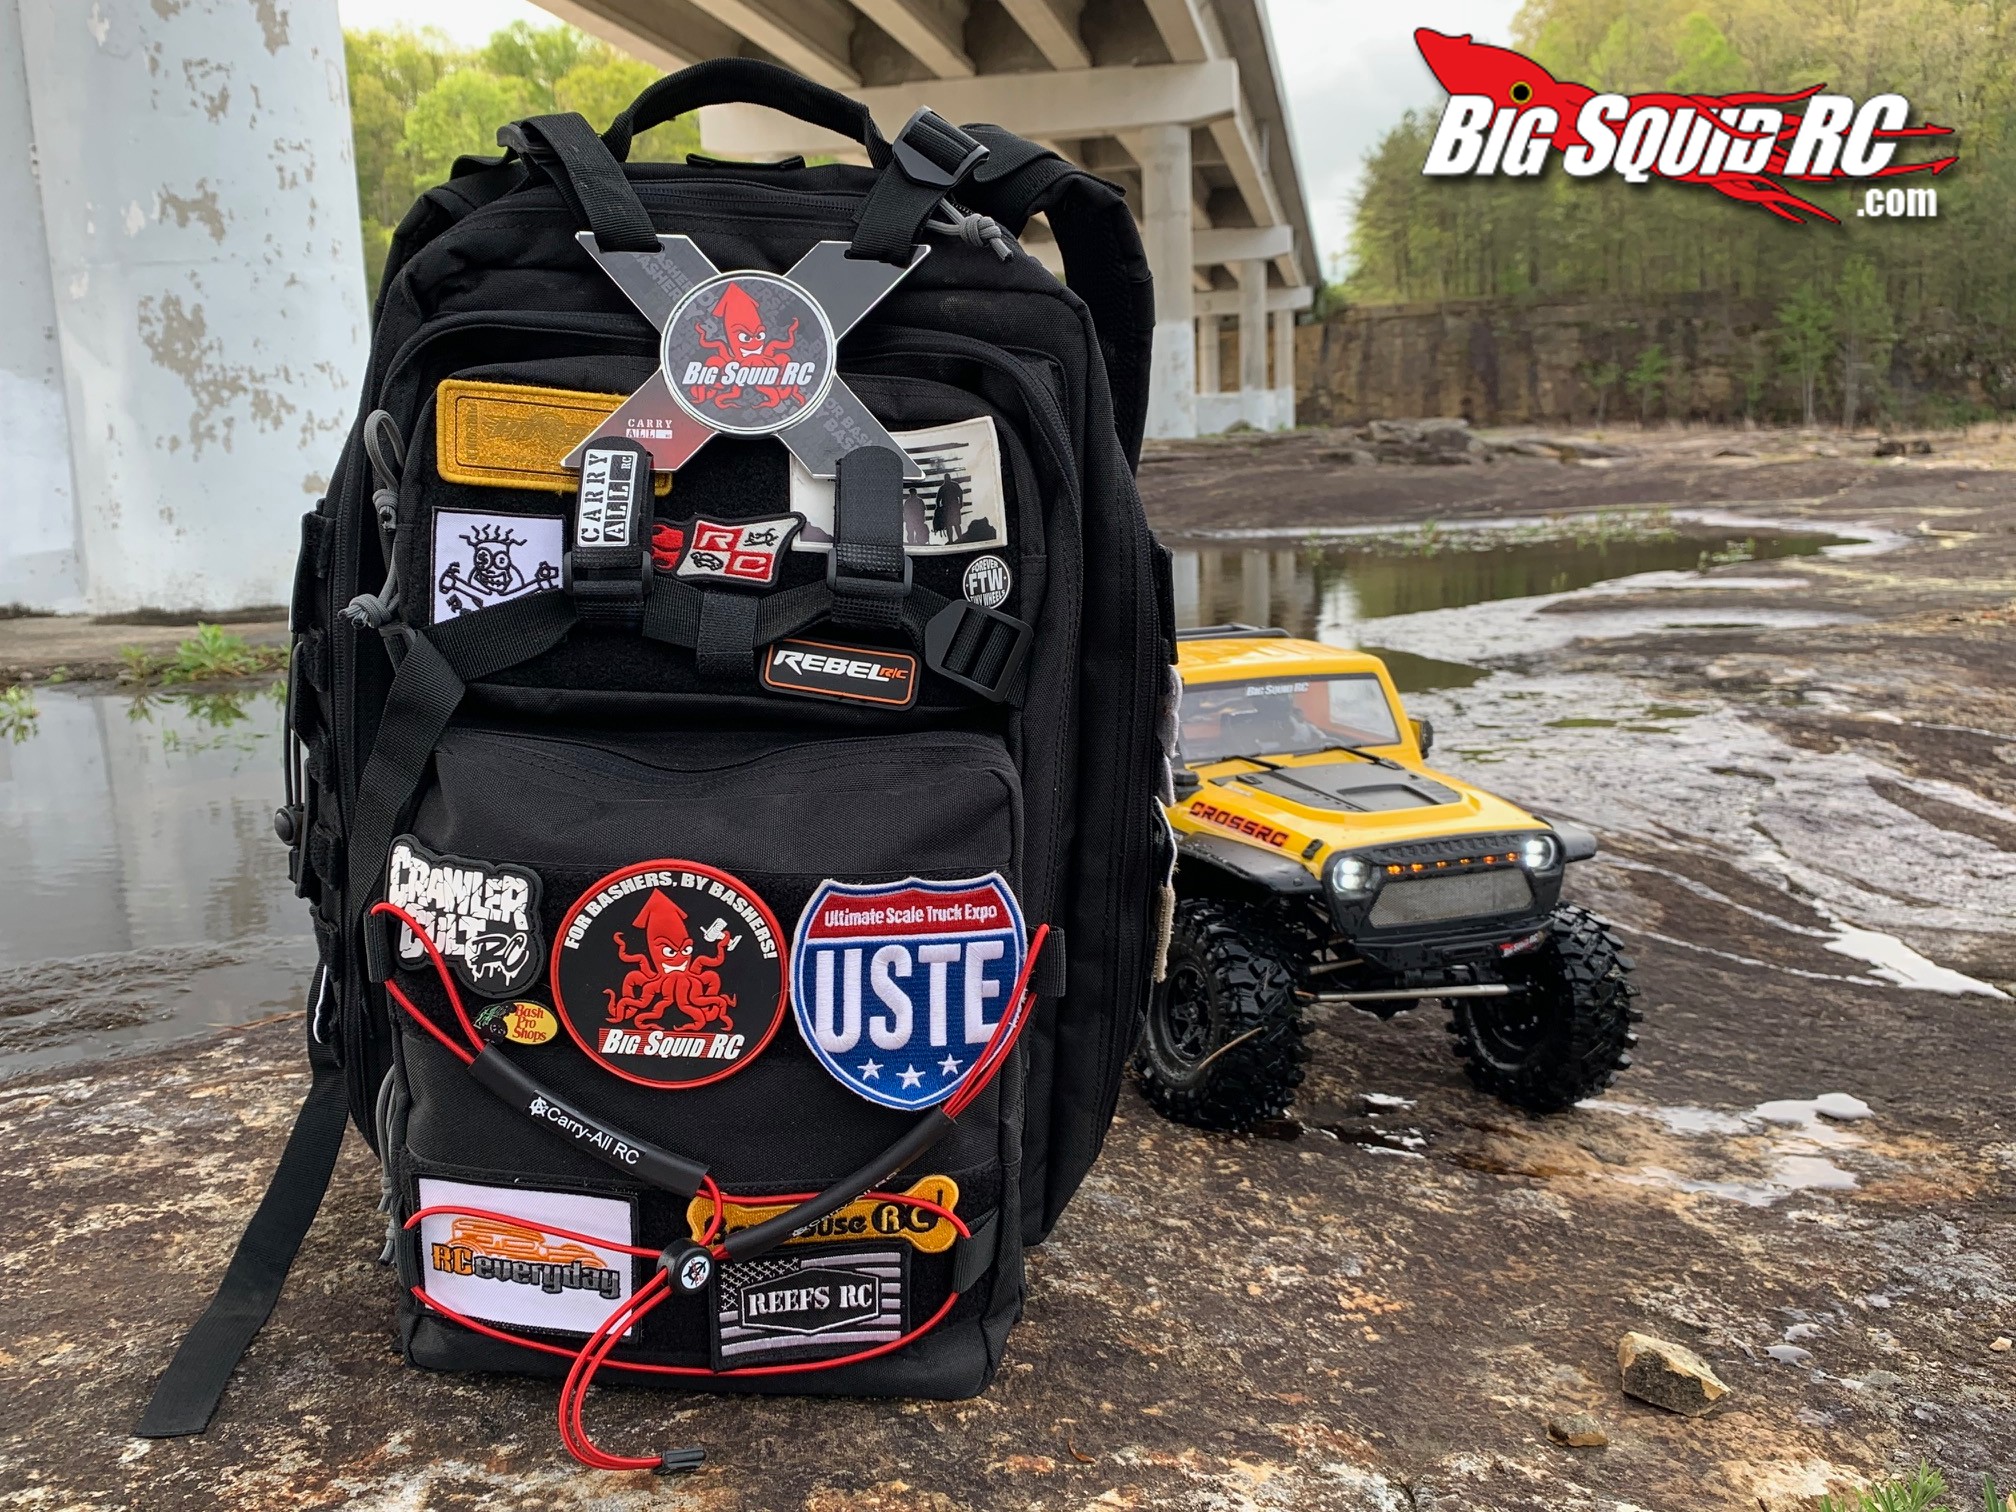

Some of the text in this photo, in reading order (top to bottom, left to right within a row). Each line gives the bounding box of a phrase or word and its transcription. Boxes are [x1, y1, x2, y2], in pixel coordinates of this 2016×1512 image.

[780, 362, 816, 386] RC
[627, 418, 673, 429] CARRY
[580, 453, 608, 543] CARRY
[605, 456, 632, 539] ALL RC
[971, 559, 999, 573] FOREVER
[968, 567, 1003, 596] FTW
[983, 590, 1006, 607] WHEELS
[773, 650, 890, 682] REBEL
[1190, 801, 1289, 847] CROSSRC
[389, 845, 529, 931] CRAWLER
[564, 871, 778, 960] FOR BASHERS, BY BASHERS!
[824, 903, 998, 927] Ultimate Scale Truck Expo
[400, 903, 487, 960] CULT
[515, 1004, 544, 1019] Bash
[815, 940, 1004, 1053] USTE
[512, 1027, 547, 1042] Shops
[517, 1016, 537, 1030] Pro
[707, 1033, 745, 1060] RC
[547, 1107, 640, 1165] Carry-All RC
[748, 1283, 873, 1317] REEFS RC
